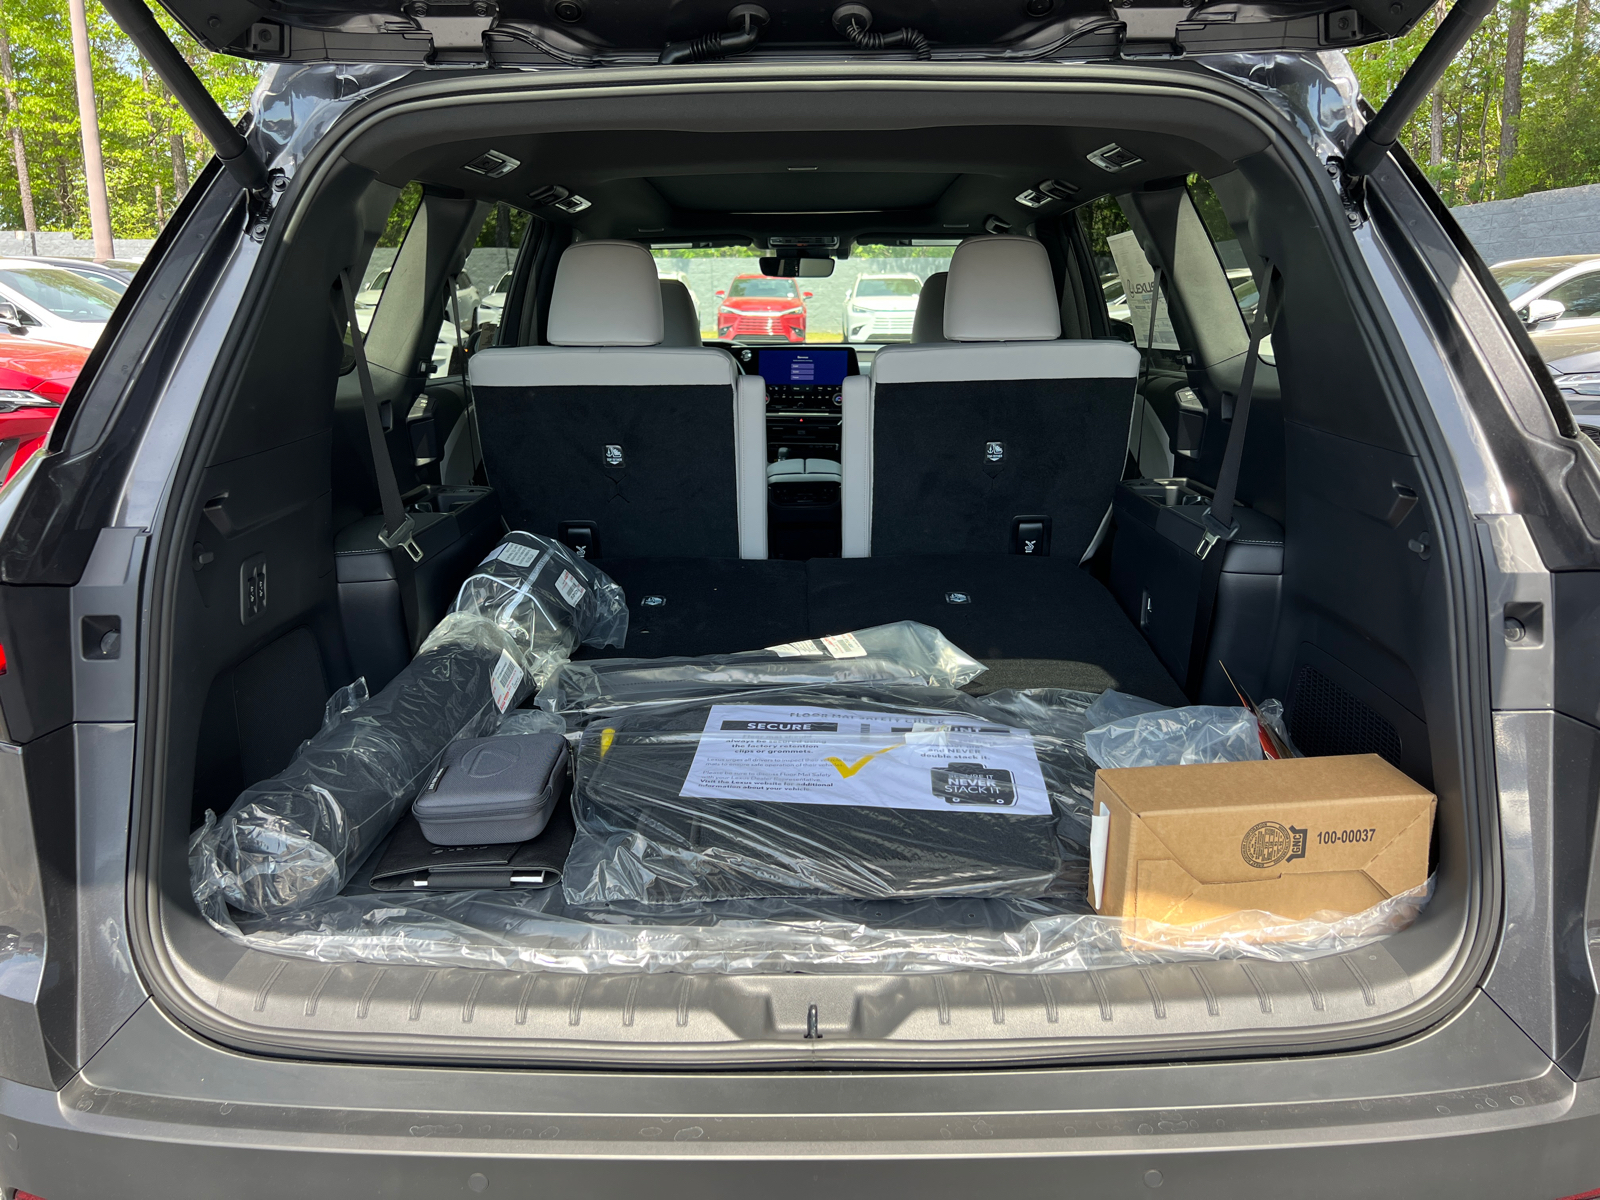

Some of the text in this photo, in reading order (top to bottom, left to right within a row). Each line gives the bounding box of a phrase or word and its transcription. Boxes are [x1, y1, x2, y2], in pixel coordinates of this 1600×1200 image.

[747, 722, 812, 731] SECURE
[947, 778, 996, 787] NEVER
[944, 785, 1002, 794] STACK IT
[1317, 828, 1376, 845] 100-00037
[1291, 834, 1302, 853] GNC
